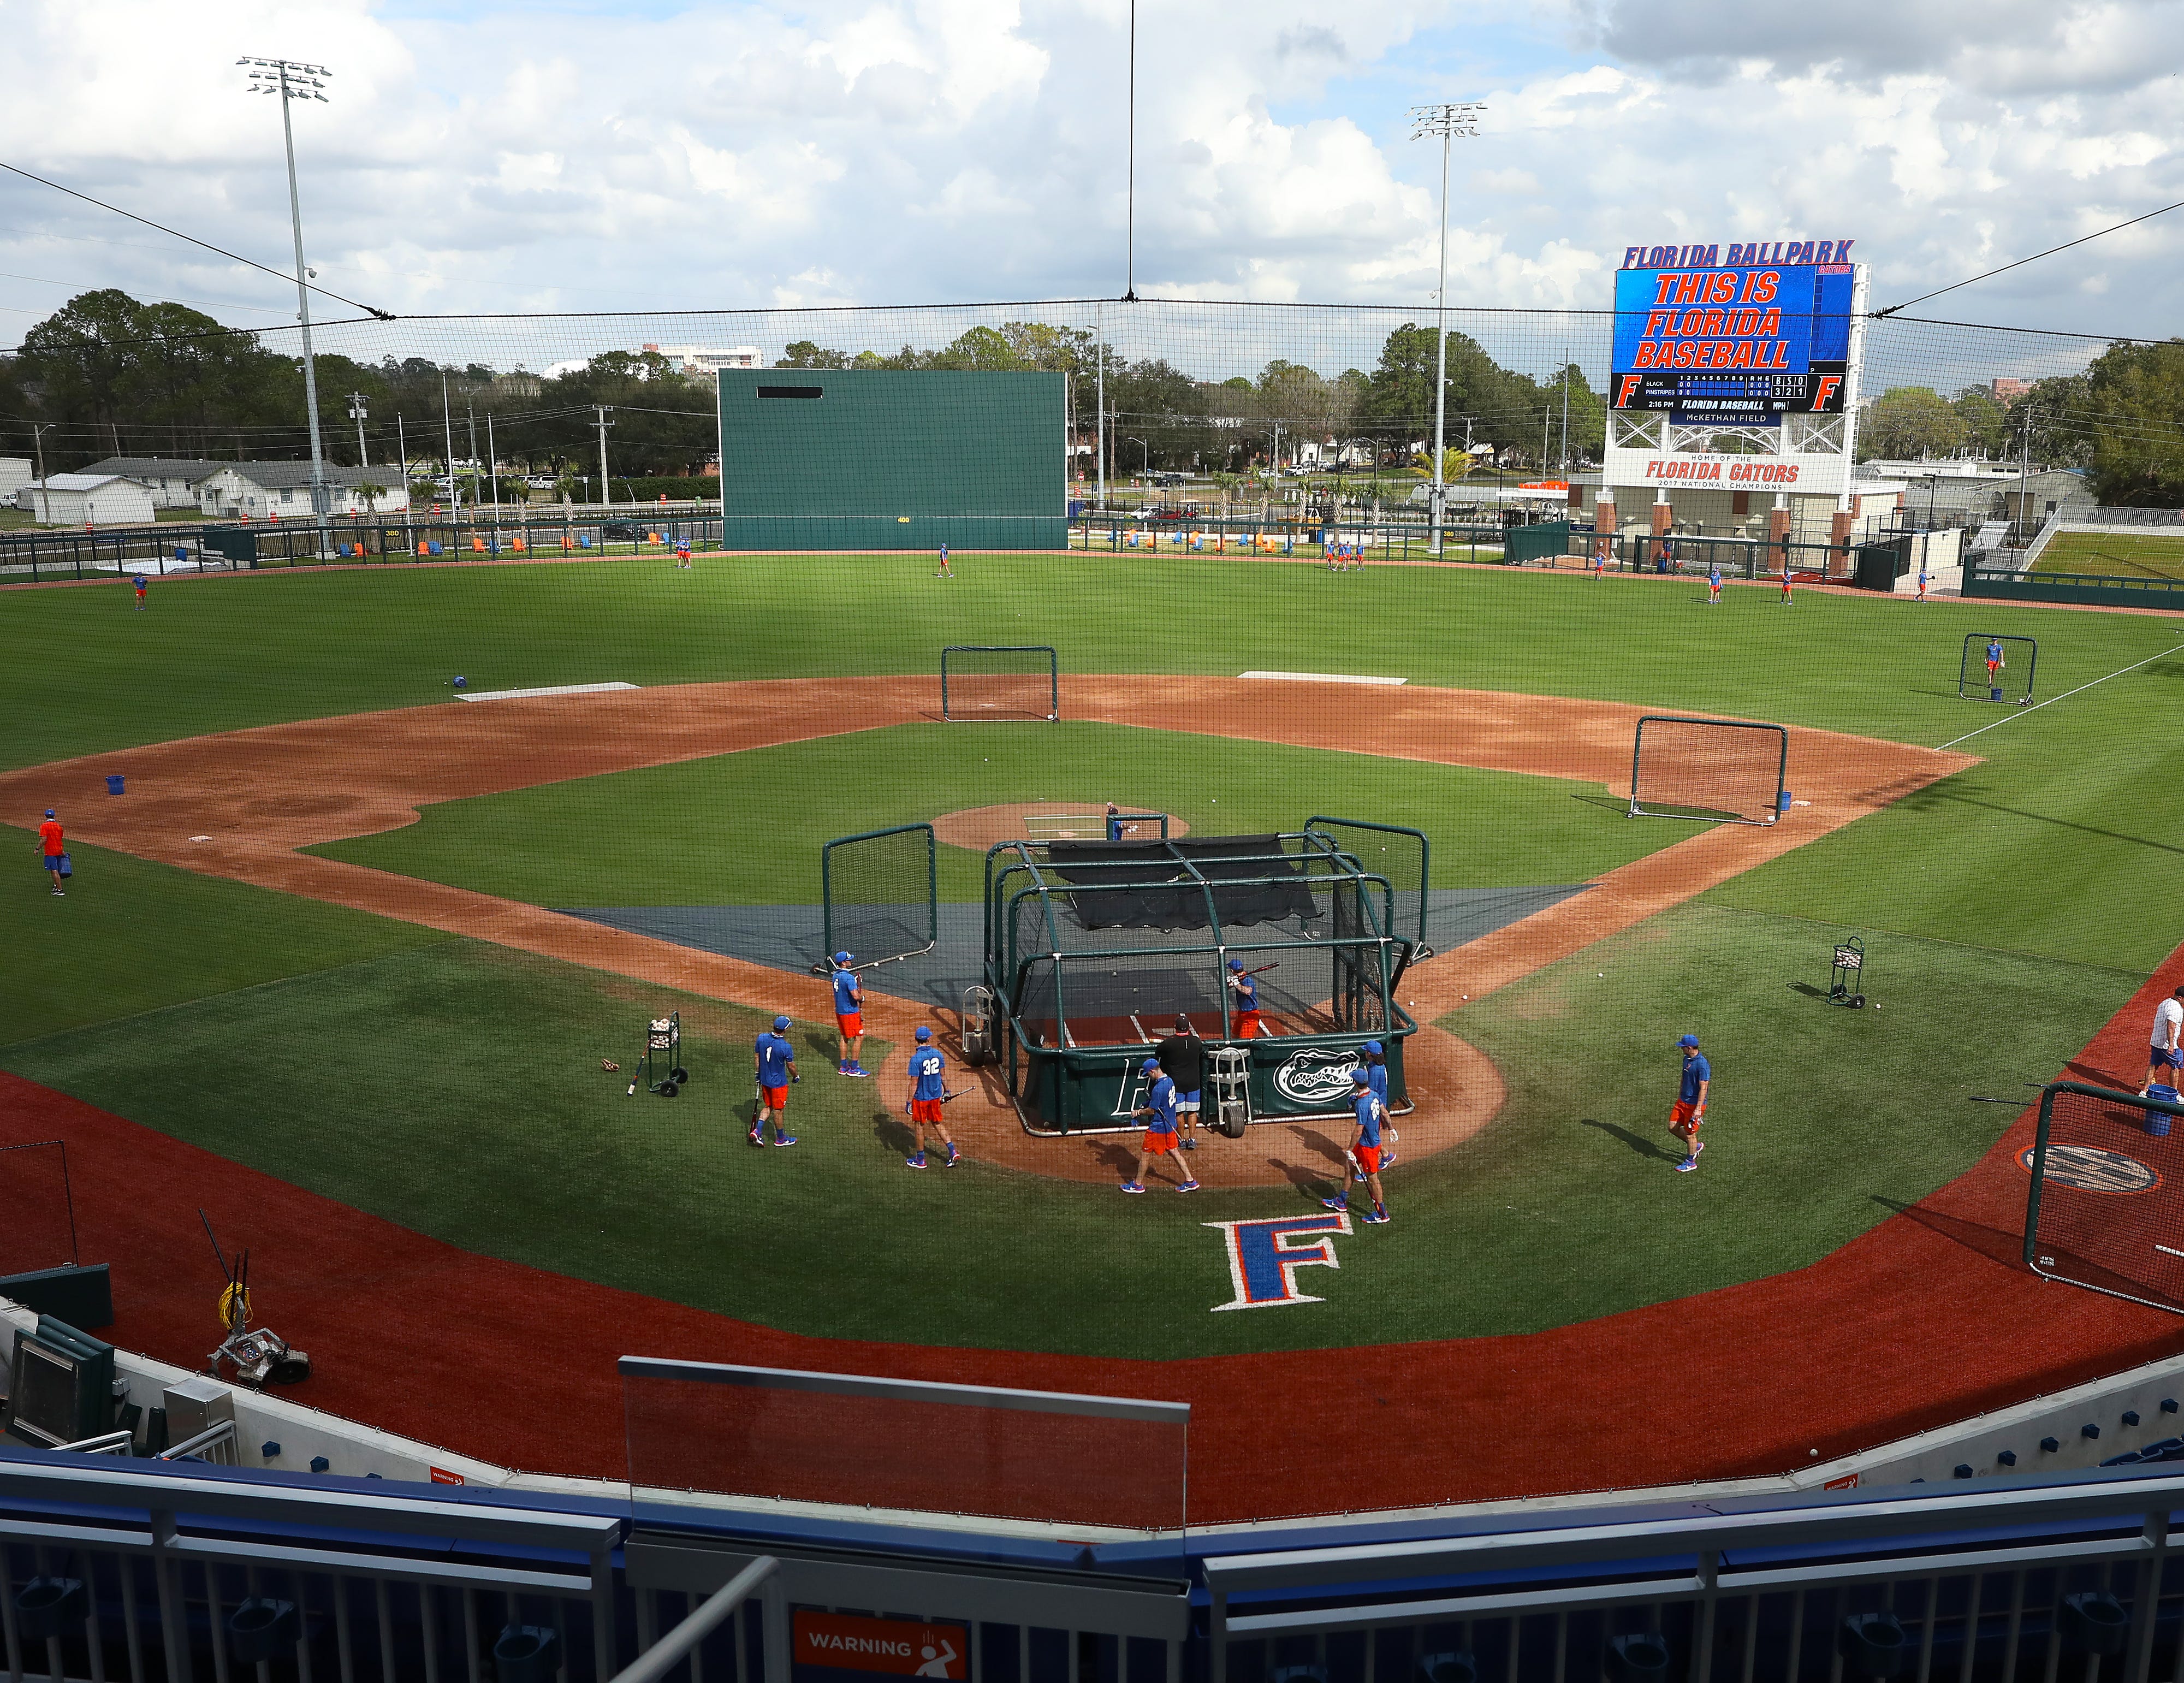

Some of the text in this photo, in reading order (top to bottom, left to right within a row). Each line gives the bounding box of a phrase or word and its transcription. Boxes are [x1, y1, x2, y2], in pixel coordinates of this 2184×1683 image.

[1622, 240, 1855, 269] FLORIDA BALLPARK
[1818, 264, 1851, 274] GATORS
[1653, 271, 1781, 304] THIS IS
[1641, 307, 1782, 337] FLORIDA
[1631, 341, 1790, 369] BASEBALL
[1613, 375, 1642, 408] F
[1809, 376, 1842, 411] F
[1682, 400, 1764, 410] FLORIDA BASEBALL
[1645, 460, 1800, 483] FLORIDA GATORS
[923, 1057, 940, 1075] 32
[1200, 1212, 1354, 1312] F
[433, 1472, 454, 1482] WARNING
[1827, 1481, 1848, 1491] WARNING
[809, 1632, 912, 1657] WARNING
